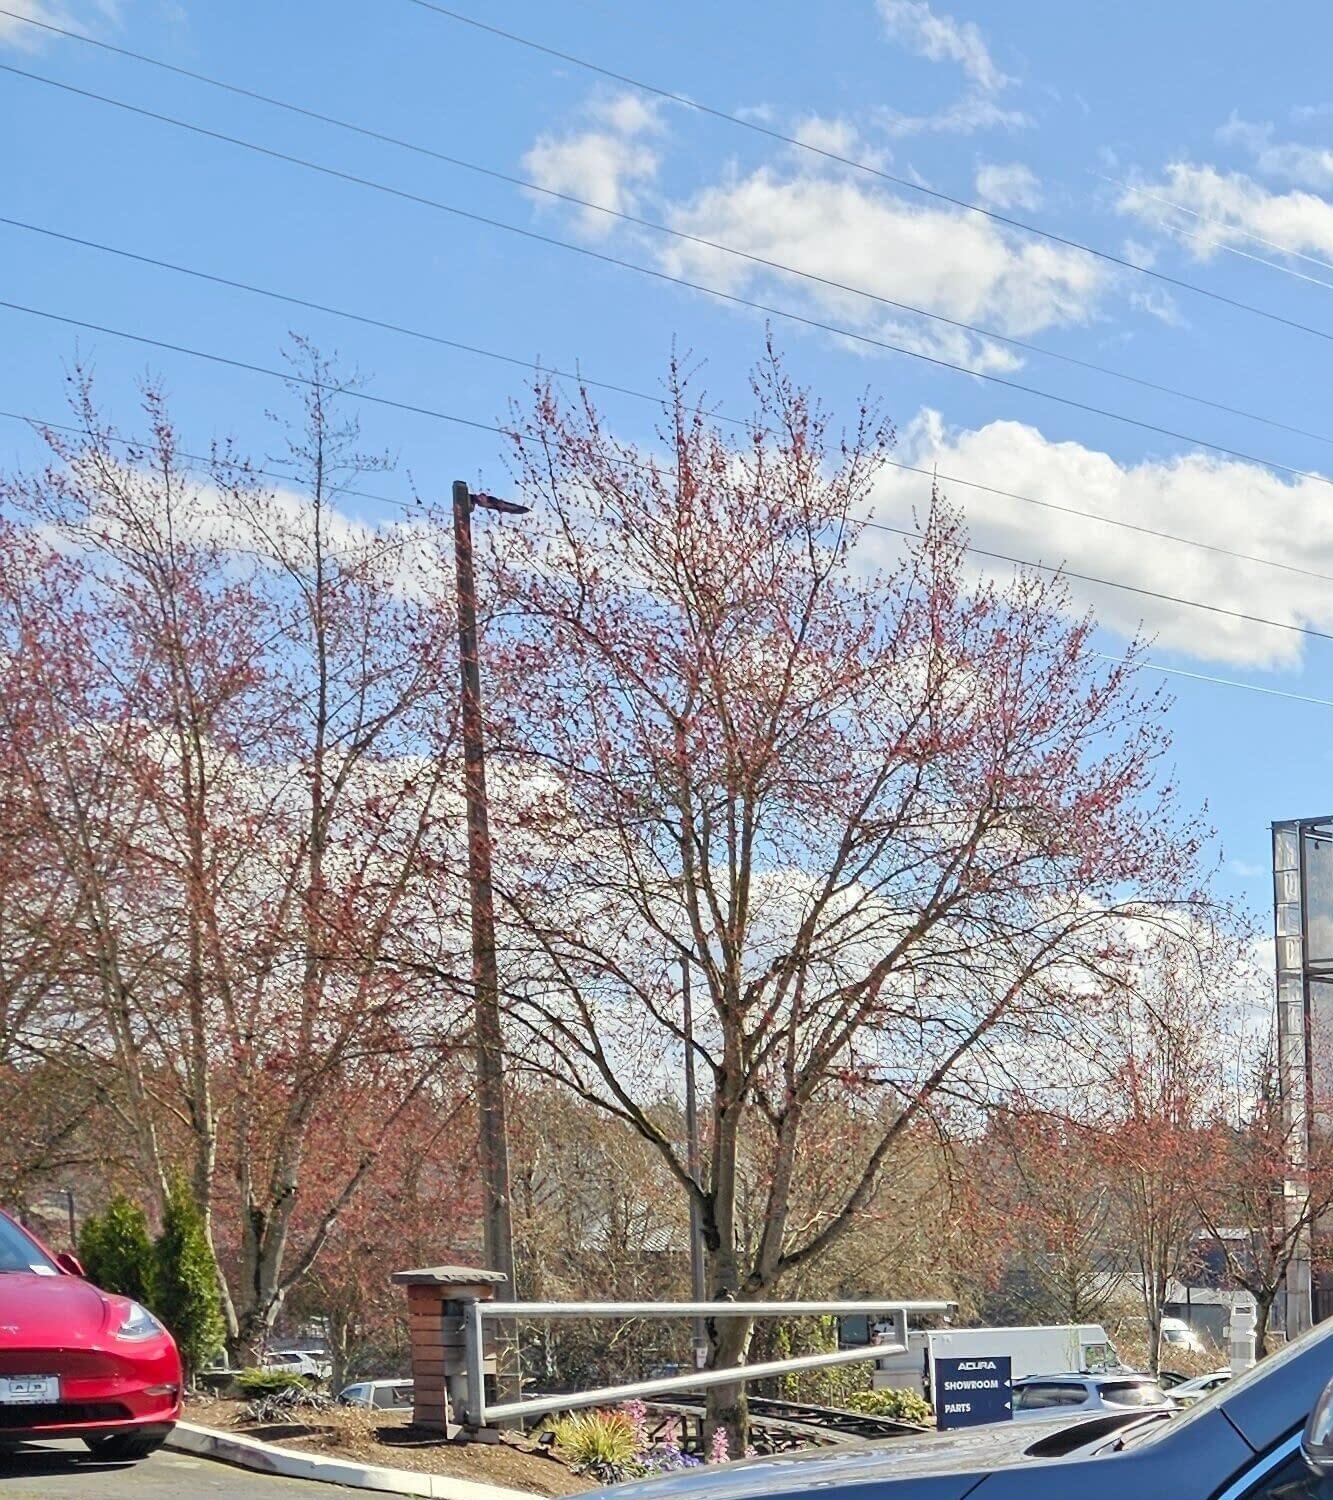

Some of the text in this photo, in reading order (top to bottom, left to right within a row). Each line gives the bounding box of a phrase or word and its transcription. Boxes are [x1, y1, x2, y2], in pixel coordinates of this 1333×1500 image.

[957, 1361, 997, 1371] ACURA
[944, 1380, 999, 1391] SHOWROOM
[944, 1403, 971, 1414] PARTS
